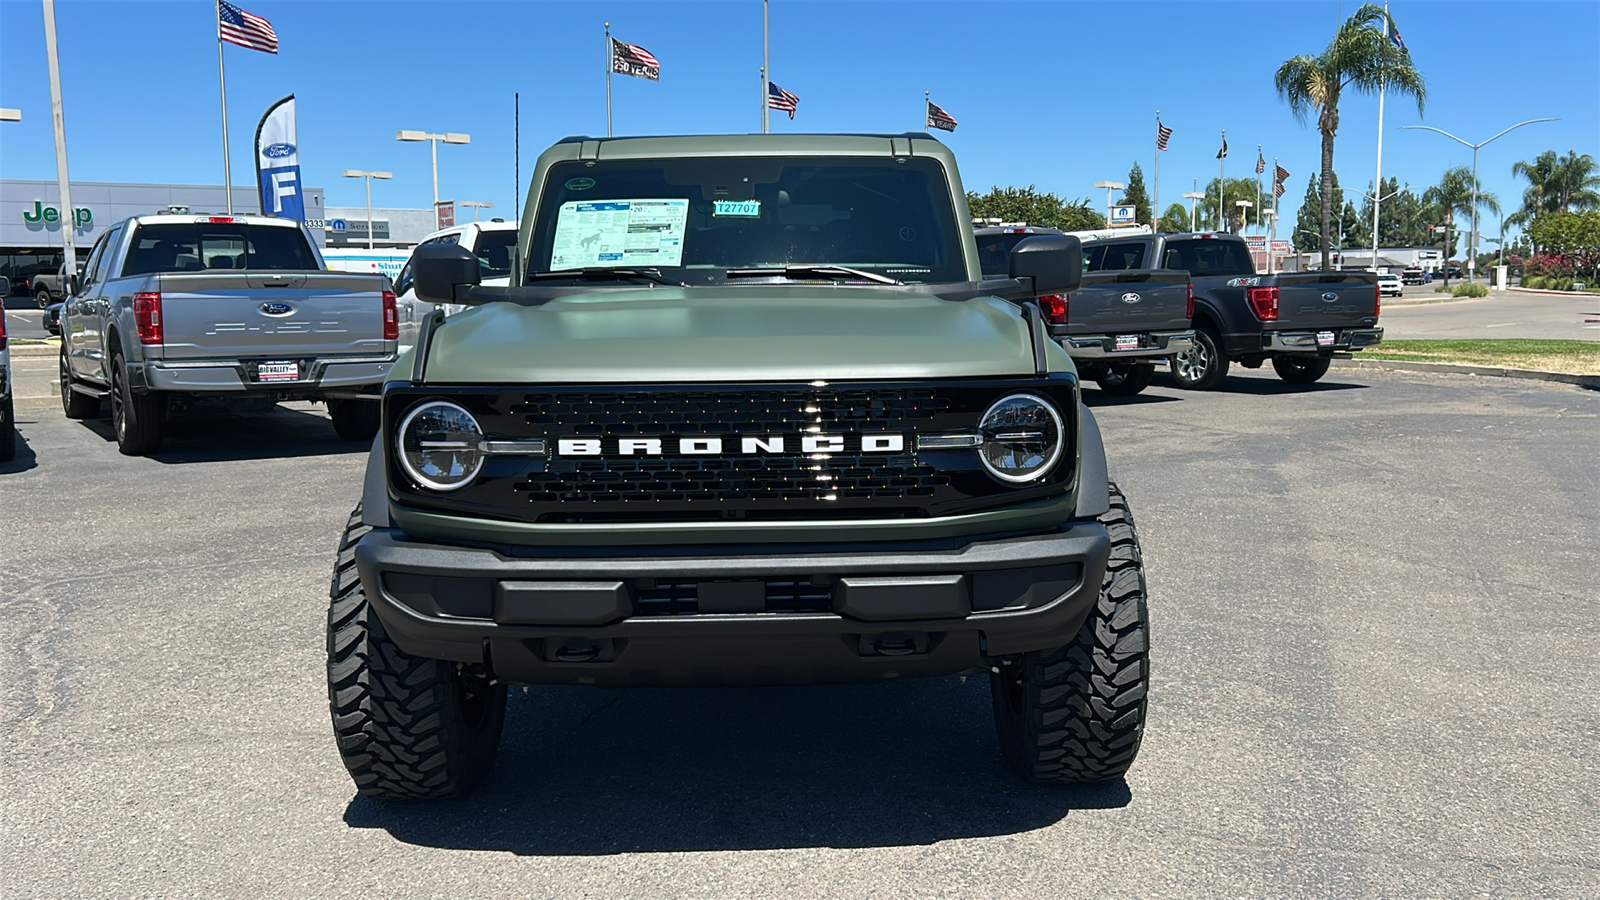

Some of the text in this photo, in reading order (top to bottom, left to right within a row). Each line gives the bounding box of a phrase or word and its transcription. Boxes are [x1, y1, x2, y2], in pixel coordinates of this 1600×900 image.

[269, 145, 290, 157] Ford
[23, 200, 92, 227] Jep
[717, 203, 757, 213] T27707
[349, 222, 384, 230] Servce
[558, 434, 904, 456] BRONCO
